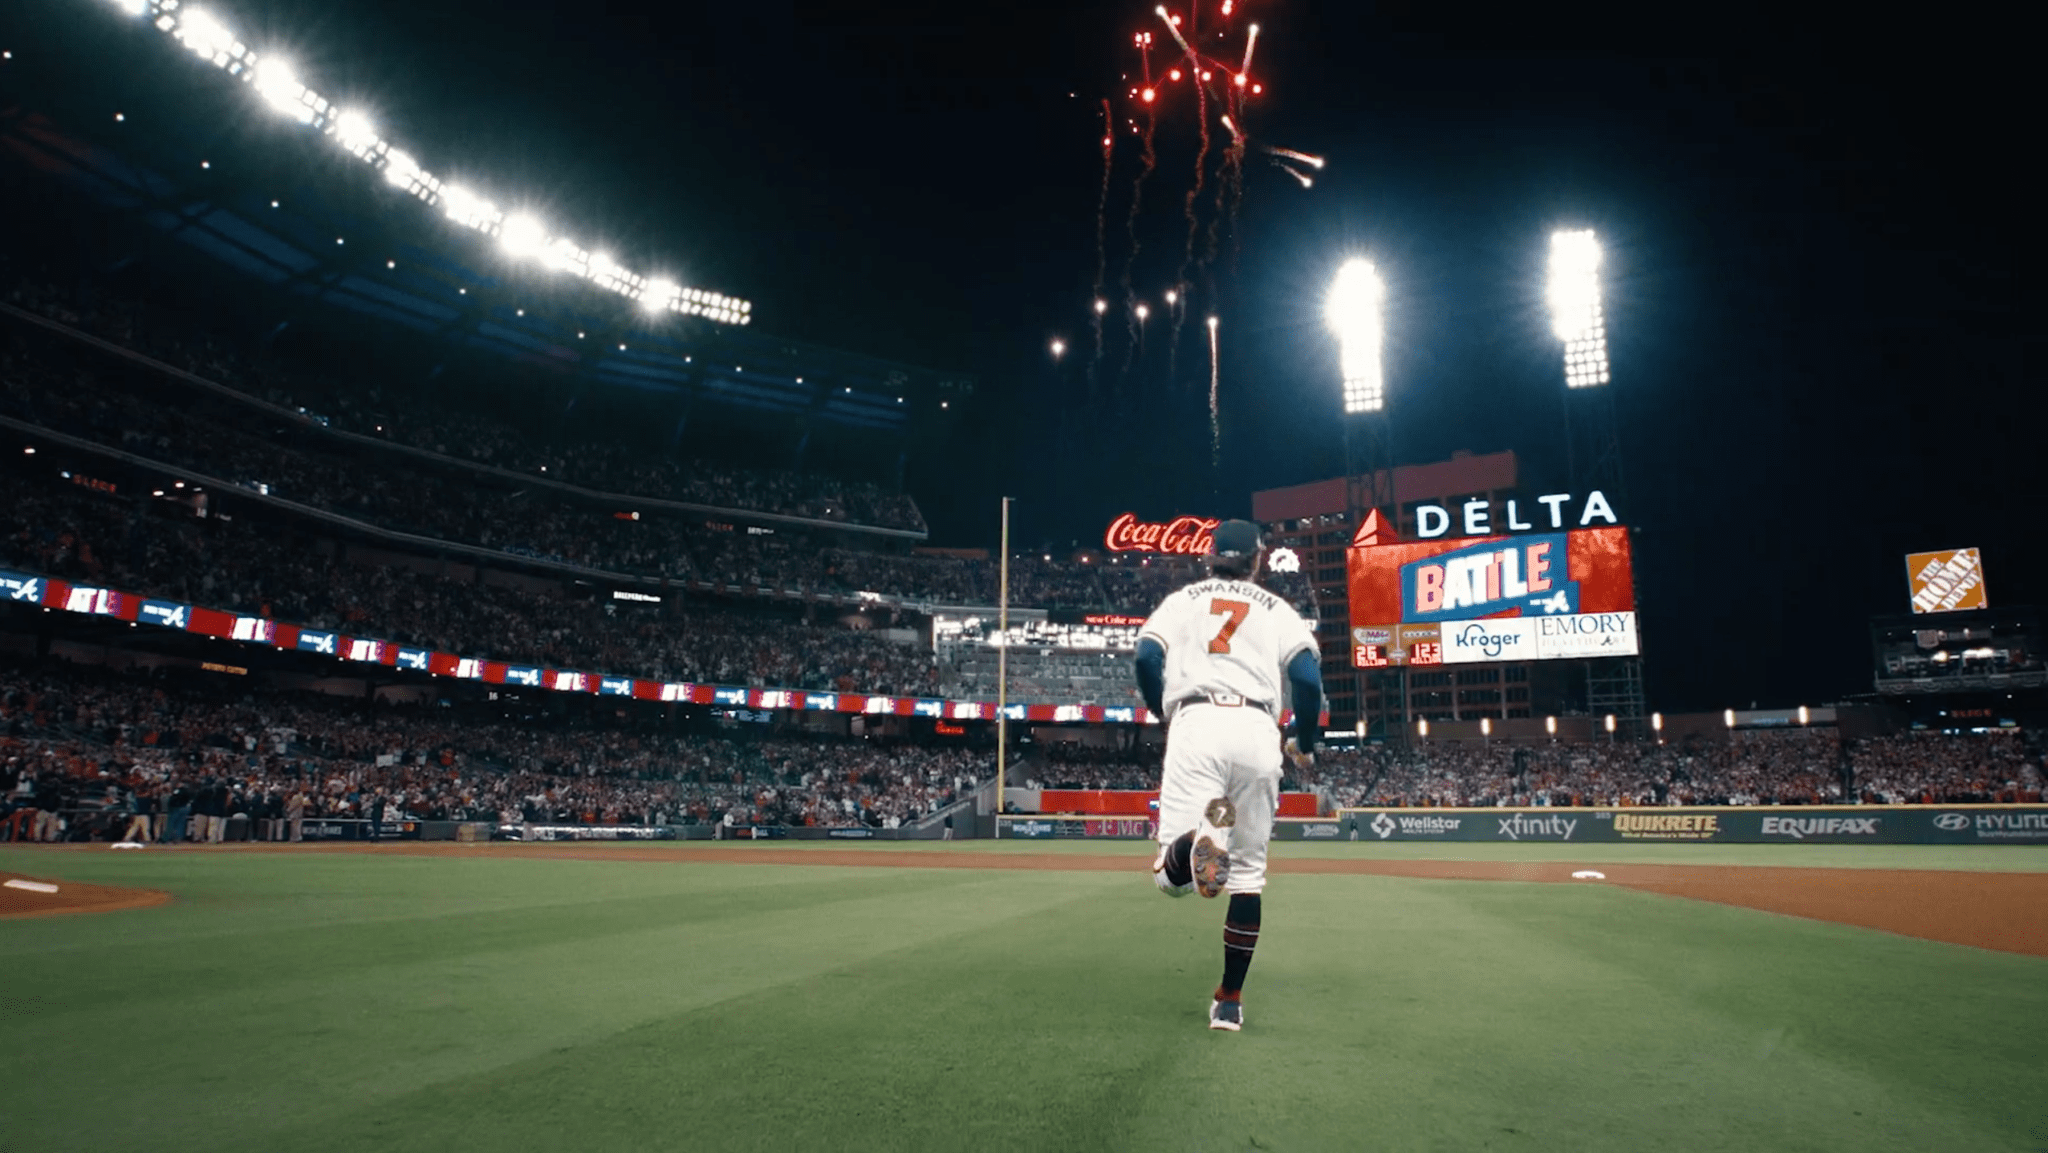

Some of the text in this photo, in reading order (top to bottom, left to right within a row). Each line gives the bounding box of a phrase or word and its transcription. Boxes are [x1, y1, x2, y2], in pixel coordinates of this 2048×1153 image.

[1416, 491, 1617, 538] DELTA
[1106, 513, 1220, 554] Coca-Cola
[1416, 543, 1552, 613] BATTLE
[1912, 549, 1979, 612] HOME
[1916, 558, 1944, 582] THE
[1188, 583, 1278, 611] SWANSON
[1940, 571, 1981, 609] DEPOT
[1208, 597, 1251, 655] 7
[1541, 613, 1630, 636] EMORY
[1356, 645, 1377, 659] 26
[1415, 643, 1441, 658] 123
[1456, 623, 1521, 658] Kroger
[1399, 816, 1461, 830] Wellstar
[1498, 813, 1577, 840] xfinity
[1613, 813, 1718, 832] QUIKRETE
[1761, 817, 1877, 838] EQUIFAX
